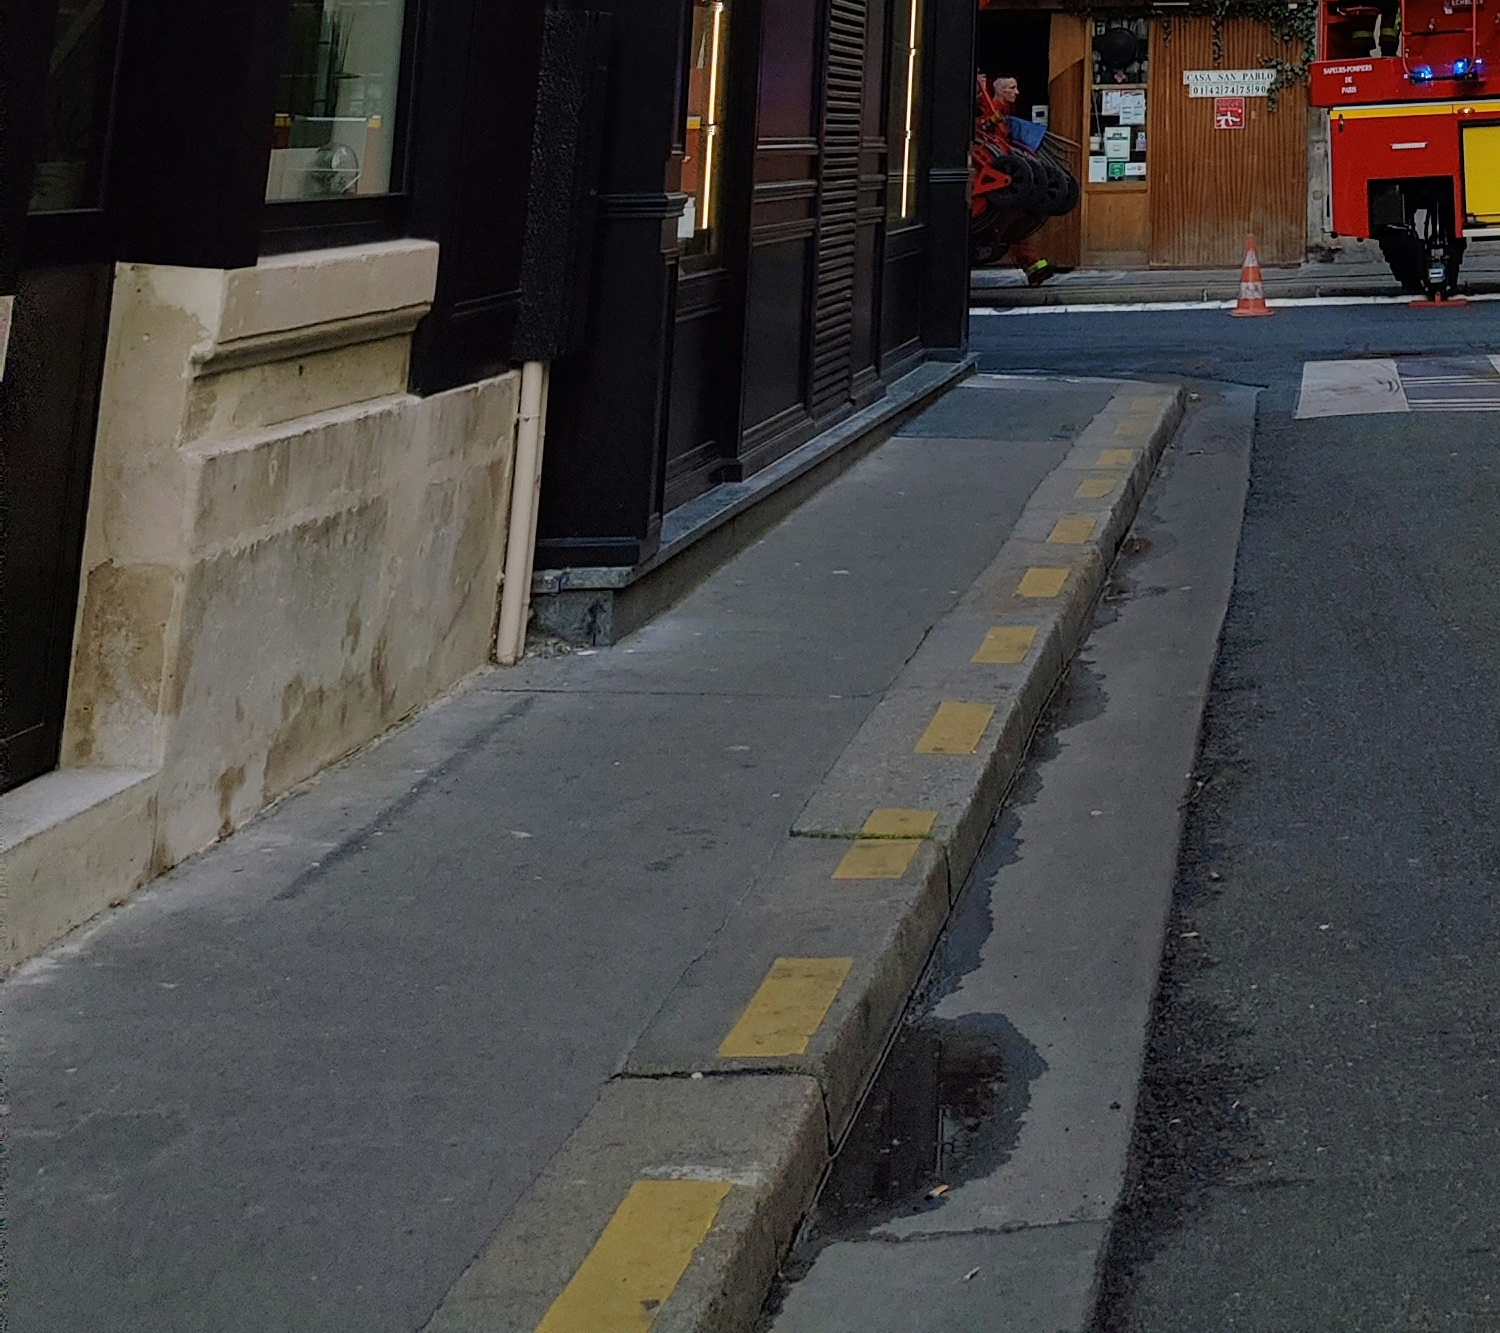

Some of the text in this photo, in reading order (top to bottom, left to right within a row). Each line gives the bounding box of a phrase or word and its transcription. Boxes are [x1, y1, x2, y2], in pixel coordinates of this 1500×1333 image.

[1187, 72, 1273, 82] CASA SAN PABLO
